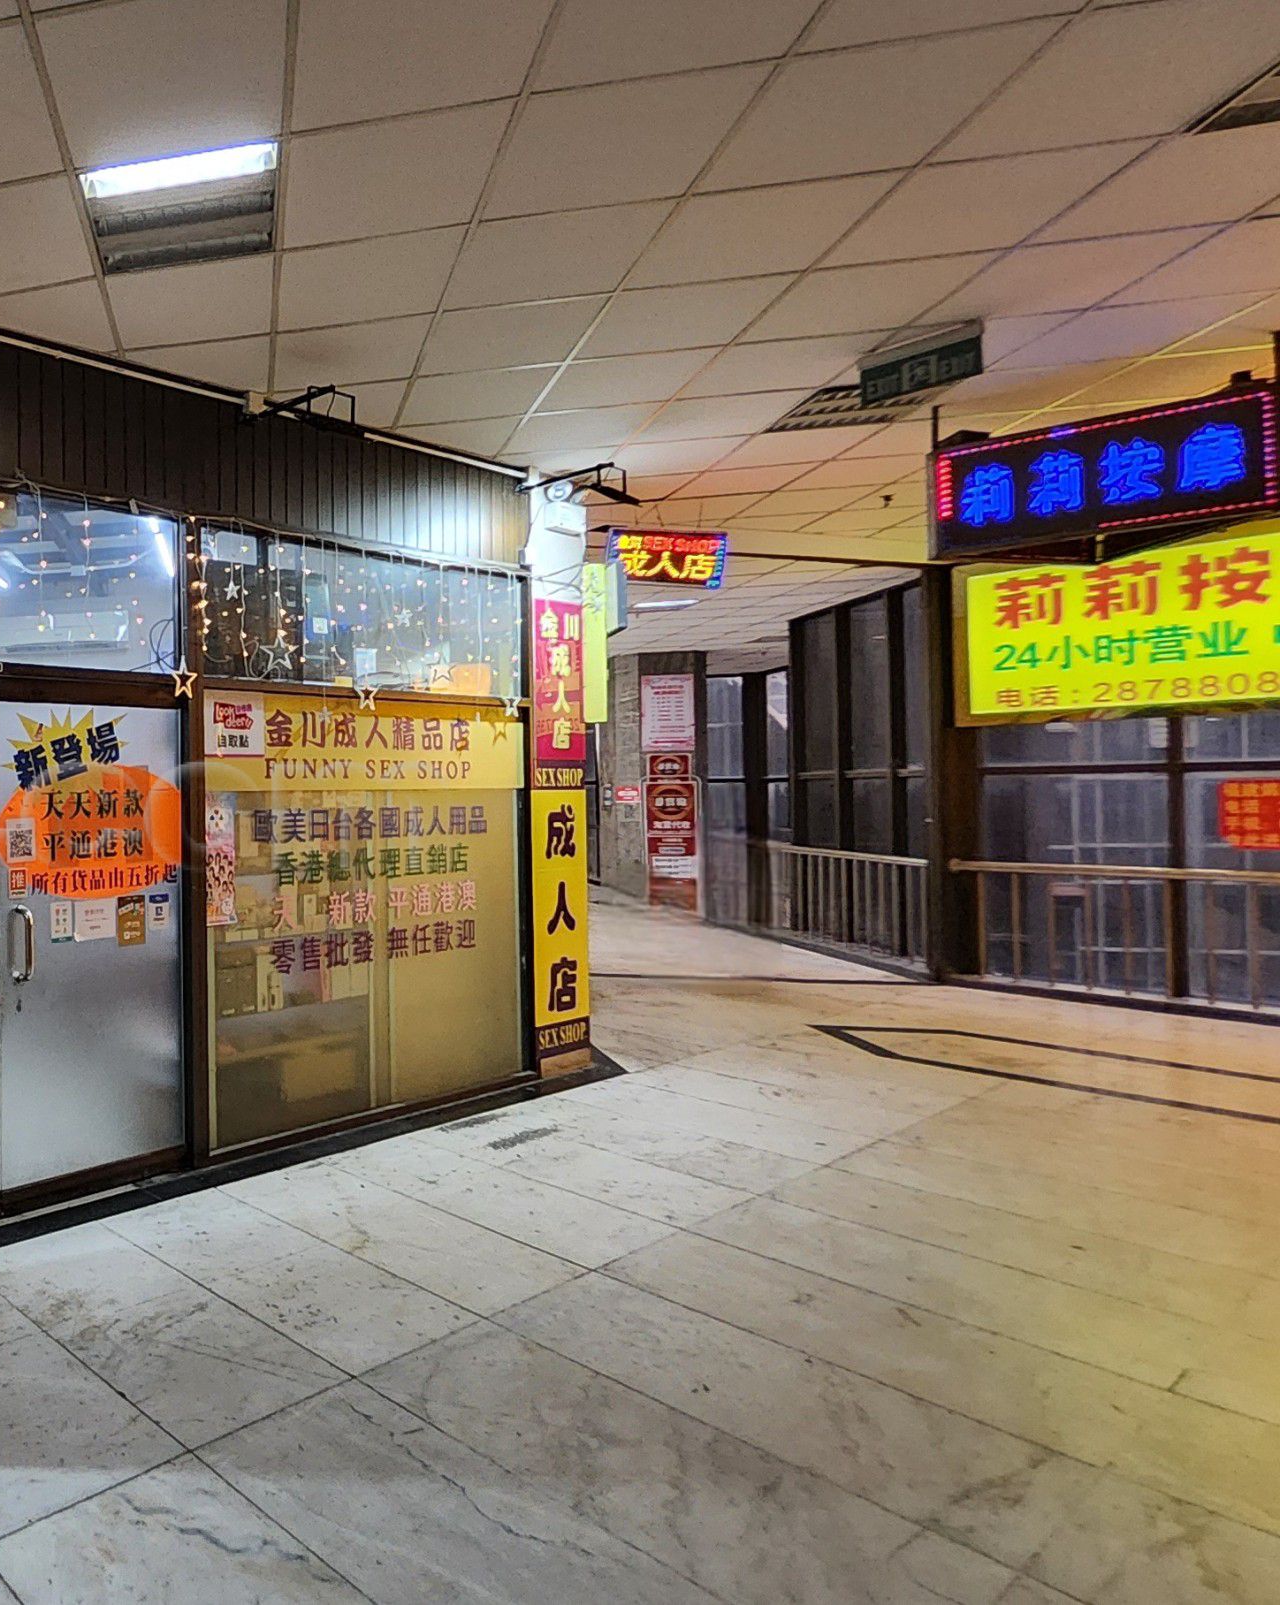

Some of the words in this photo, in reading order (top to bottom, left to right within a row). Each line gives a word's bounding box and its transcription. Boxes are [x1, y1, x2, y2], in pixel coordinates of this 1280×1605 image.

[991, 546, 1271, 631] 莉莉按
[992, 619, 1250, 671] 24小时营业
[217, 734, 249, 748] 自取點
[265, 709, 471, 752] 金川成人精品店
[13, 721, 120, 790] 新登場
[265, 758, 352, 780] FUNNY
[366, 759, 405, 780] SEX
[417, 761, 471, 780] SHOP
[534, 767, 556, 788] SEX
[556, 766, 584, 788] SHOP
[41, 789, 145, 821] 天天新款
[252, 805, 488, 844] 歐美日台各國成人用品
[41, 827, 144, 862] 平通港澳
[275, 842, 471, 888] 香港總代理直銷店
[11, 871, 25, 889] 推
[387, 878, 477, 921] 平通港澳
[545, 803, 578, 1013] 成人店
[270, 929, 375, 976] 零售批發
[387, 918, 477, 960] 無任歡迎
[538, 1029, 559, 1050] SEX
[559, 1022, 588, 1045] SHOP
